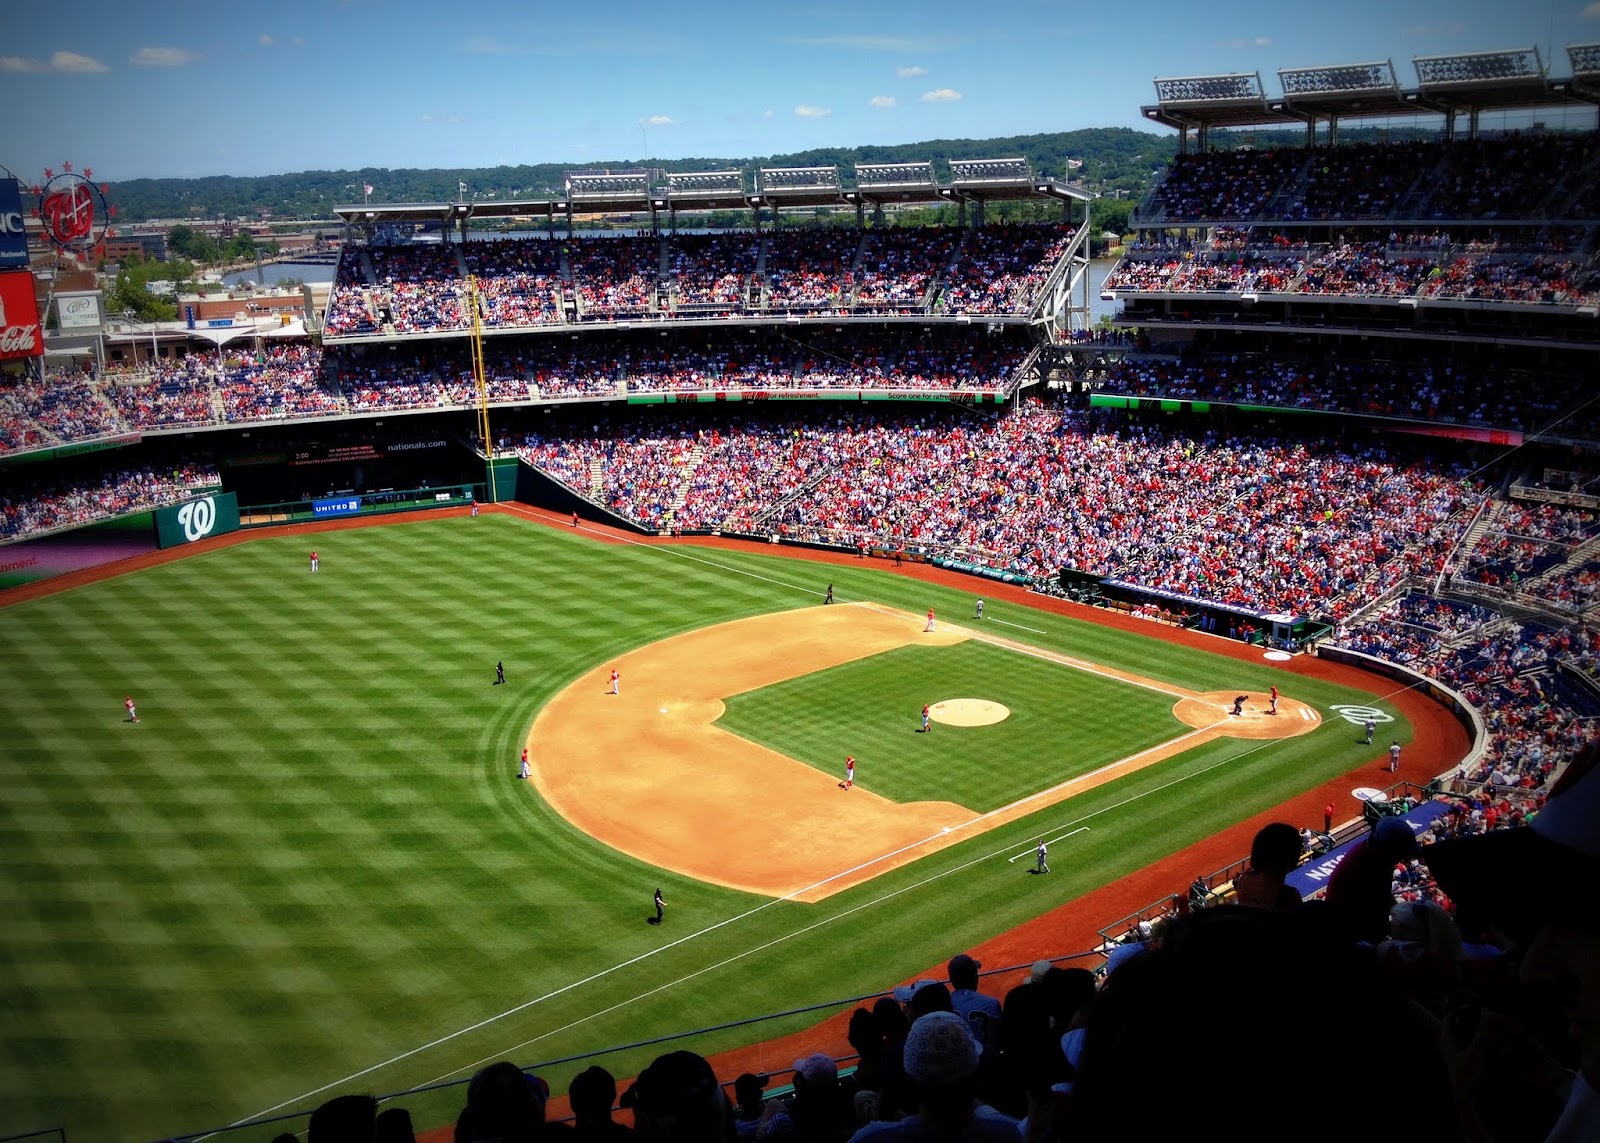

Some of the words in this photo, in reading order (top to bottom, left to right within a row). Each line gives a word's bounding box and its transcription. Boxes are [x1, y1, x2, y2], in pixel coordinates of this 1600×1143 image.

[888, 392, 907, 400] Score
[922, 392, 932, 400] for
[59, 448, 78, 456] Score
[92, 442, 101, 450] for
[387, 440, 447, 451] nationals.com
[315, 504, 348, 512] UNITED
